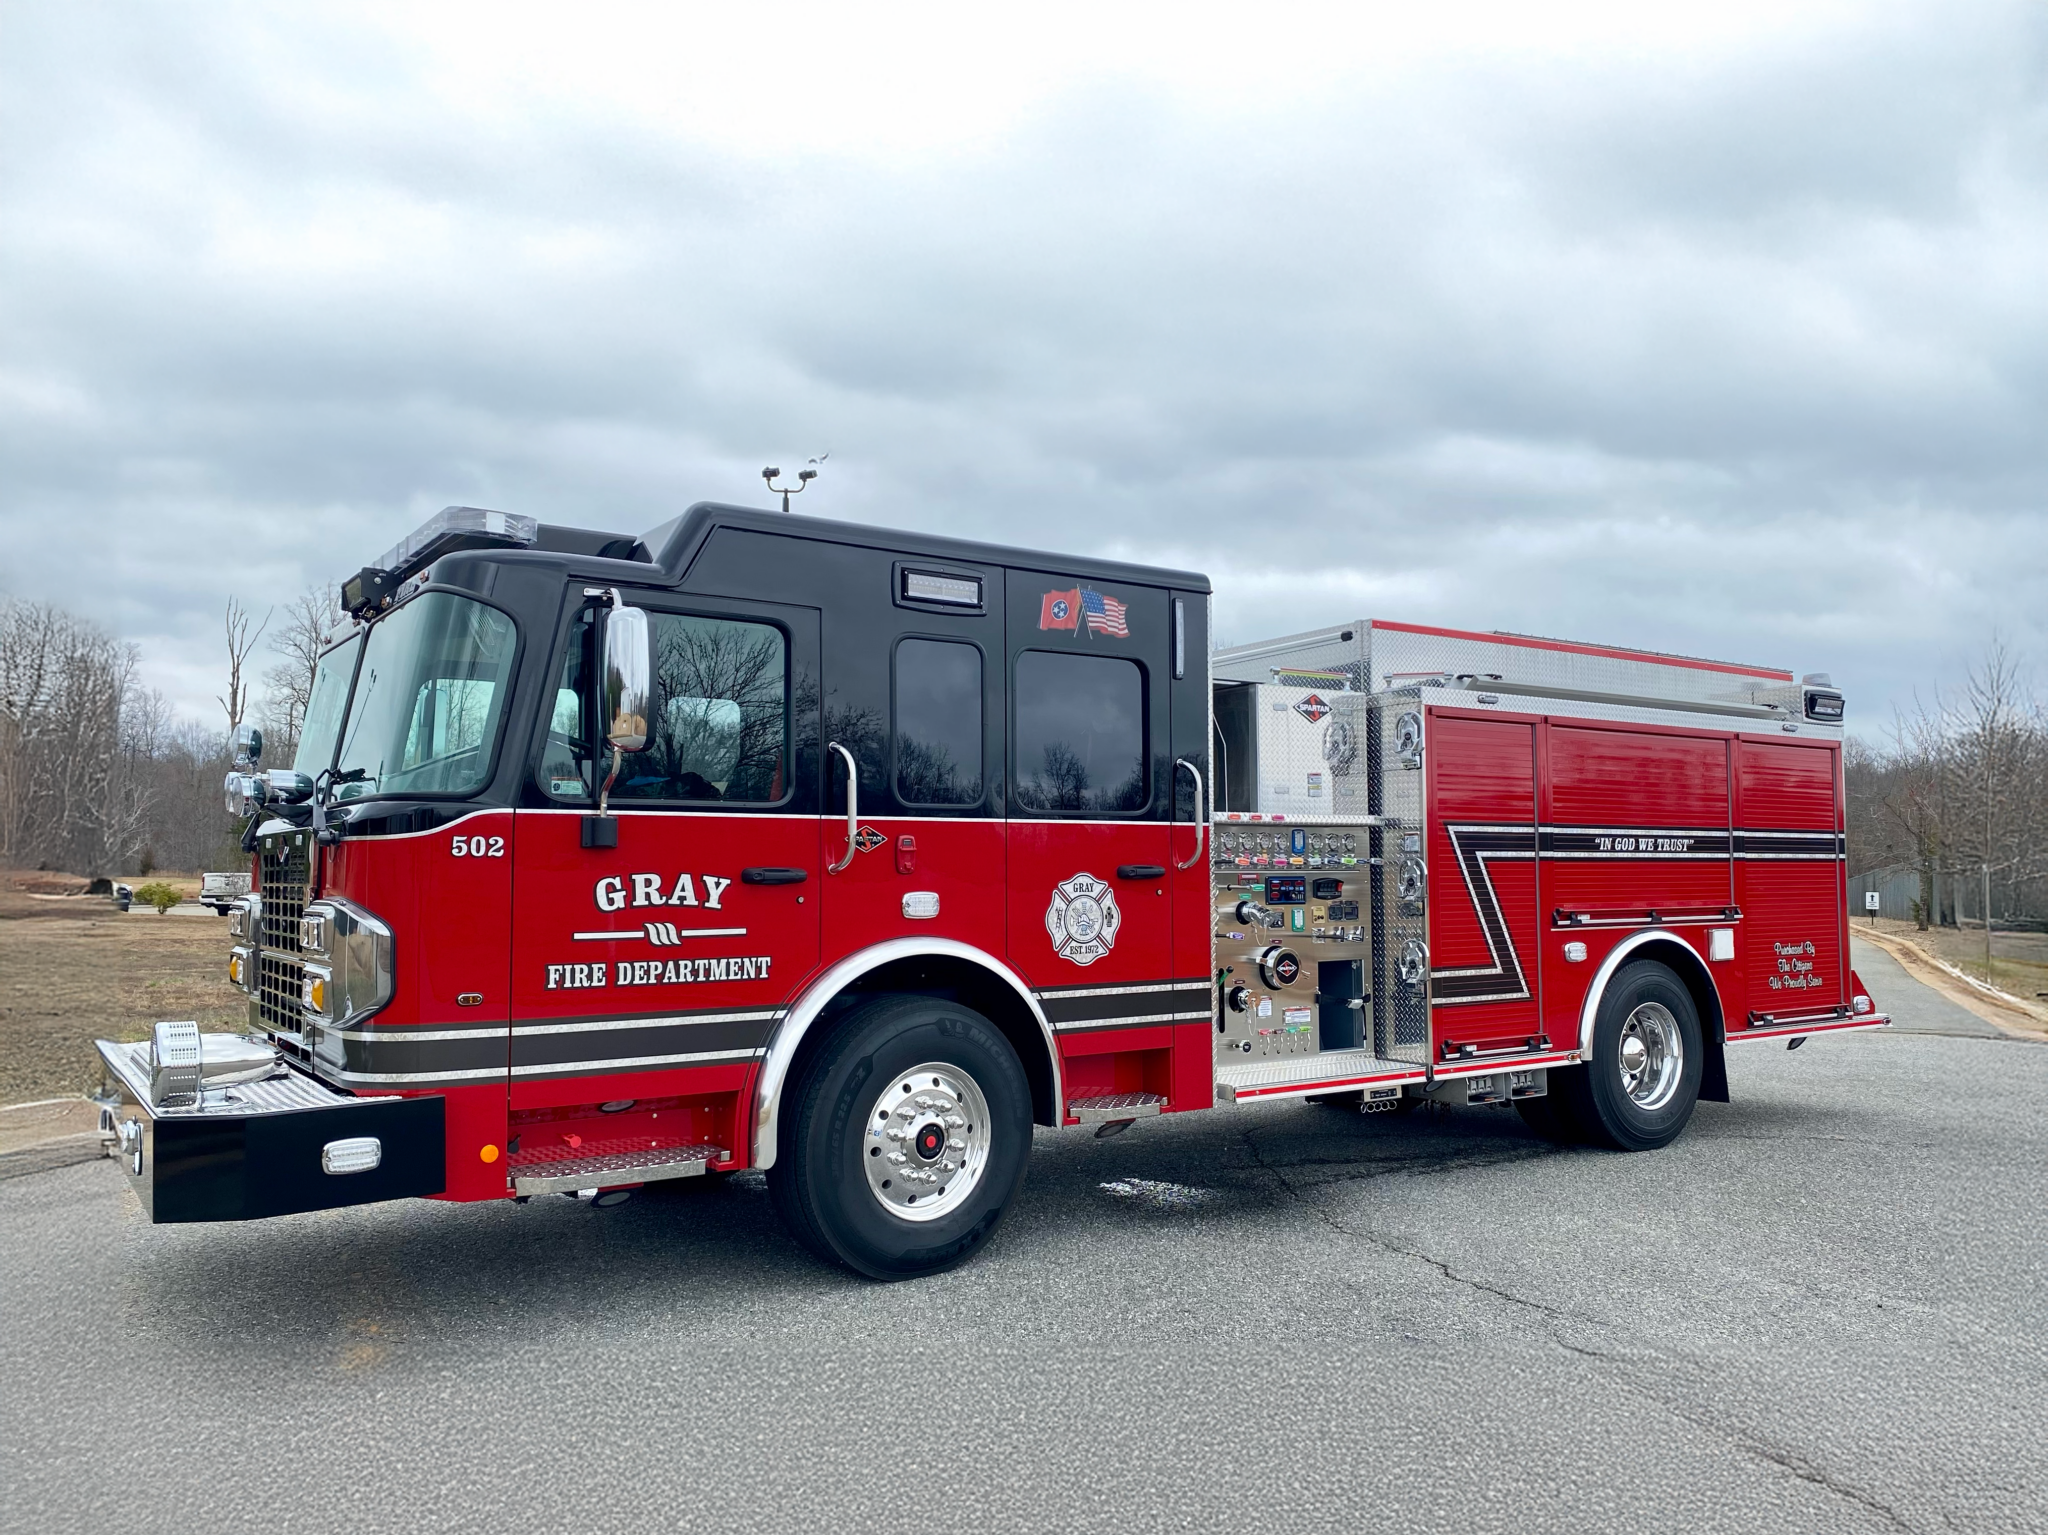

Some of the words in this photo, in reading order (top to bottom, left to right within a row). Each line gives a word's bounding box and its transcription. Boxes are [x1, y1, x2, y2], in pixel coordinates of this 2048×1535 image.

[1300, 704, 1329, 712] SPARTAN
[451, 835, 505, 858] 502
[1615, 838, 1636, 851] GOD
[1638, 838, 1654, 851] WE
[595, 873, 732, 912] GRAY
[1073, 882, 1094, 892] GRAY
[1773, 941, 1804, 955] Purchased
[1804, 940, 1815, 957] By
[1777, 957, 1791, 972] The
[547, 963, 607, 989] FIRE
[617, 957, 771, 986] DEPARTMENT
[1768, 975, 1782, 989] We
[1782, 974, 1807, 990] Proudly
[967, 1027, 1024, 1118] MICHELIN
